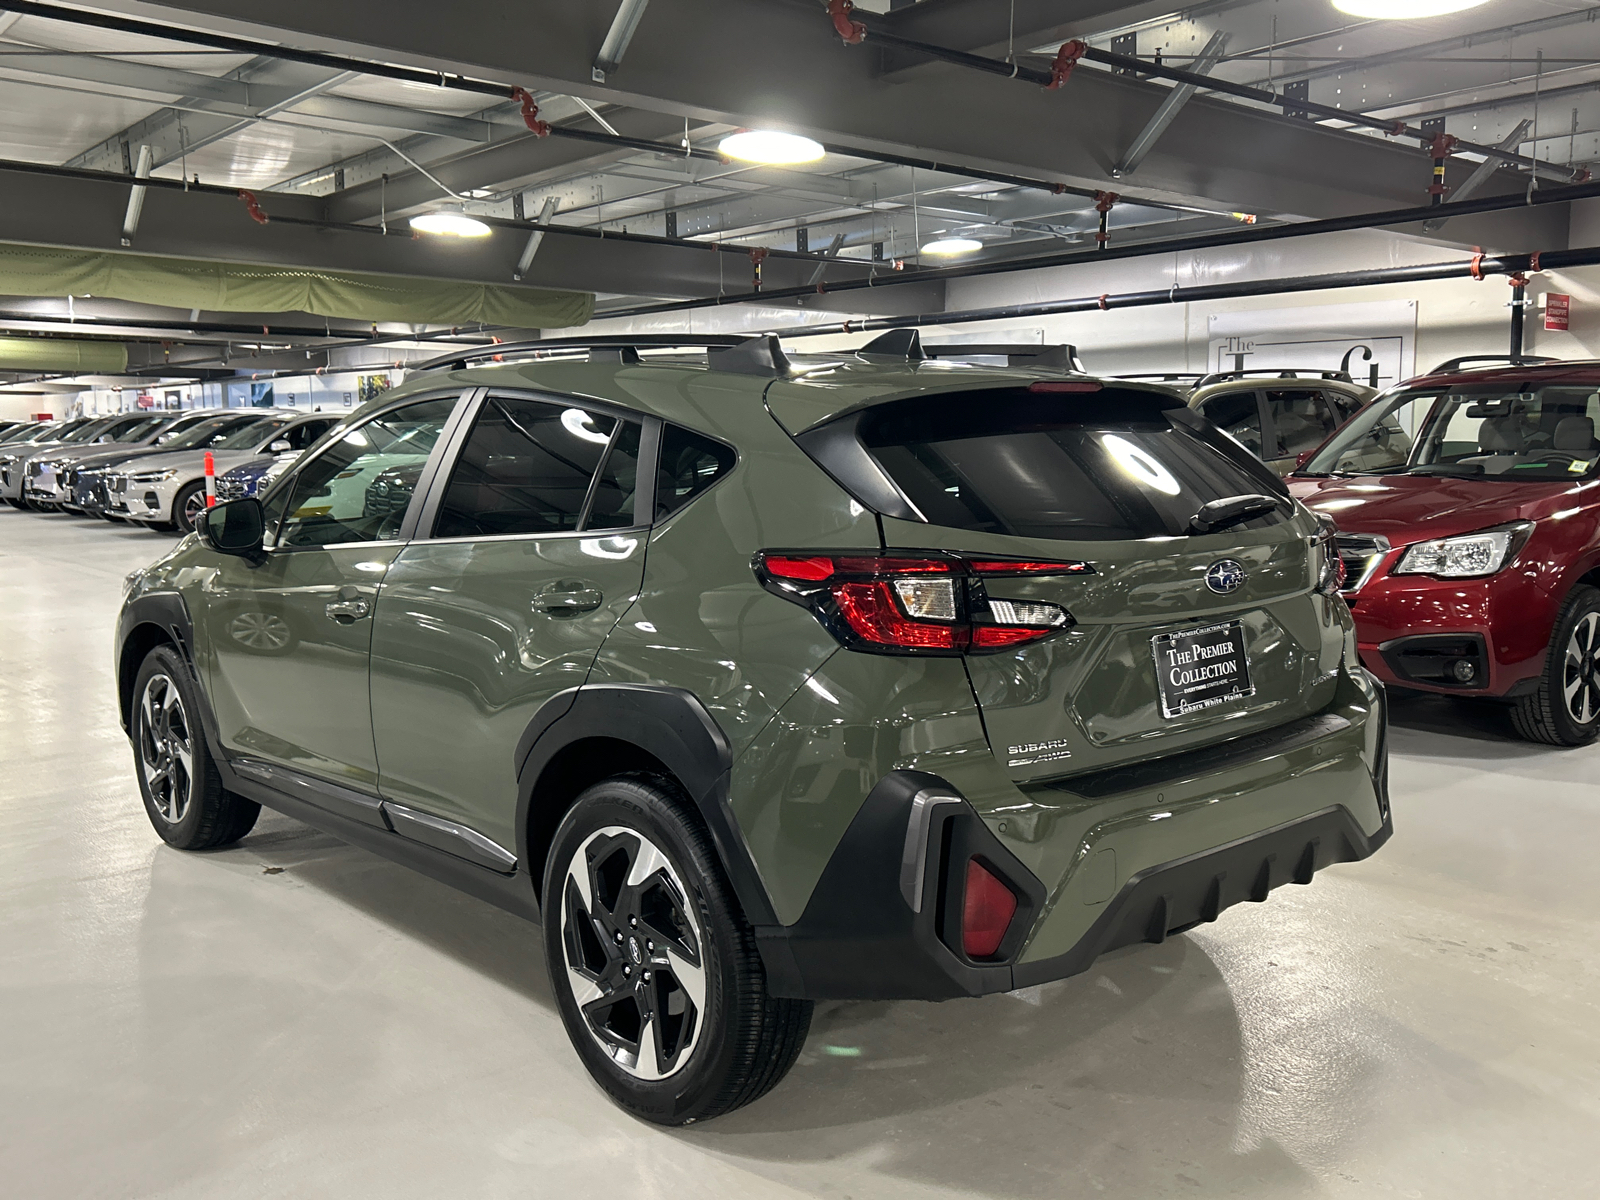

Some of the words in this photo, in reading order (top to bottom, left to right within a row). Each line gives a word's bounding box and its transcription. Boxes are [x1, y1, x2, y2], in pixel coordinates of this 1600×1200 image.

[1225, 336, 1255, 352] The
[1166, 648, 1192, 667] THE
[1191, 641, 1235, 662] PREMIER
[1169, 659, 1238, 687] COLLECTION
[1180, 701, 1204, 714] Subaru
[1203, 697, 1223, 707] White
[1223, 692, 1243, 702] Plains
[1007, 738, 1068, 755] SUBARU
